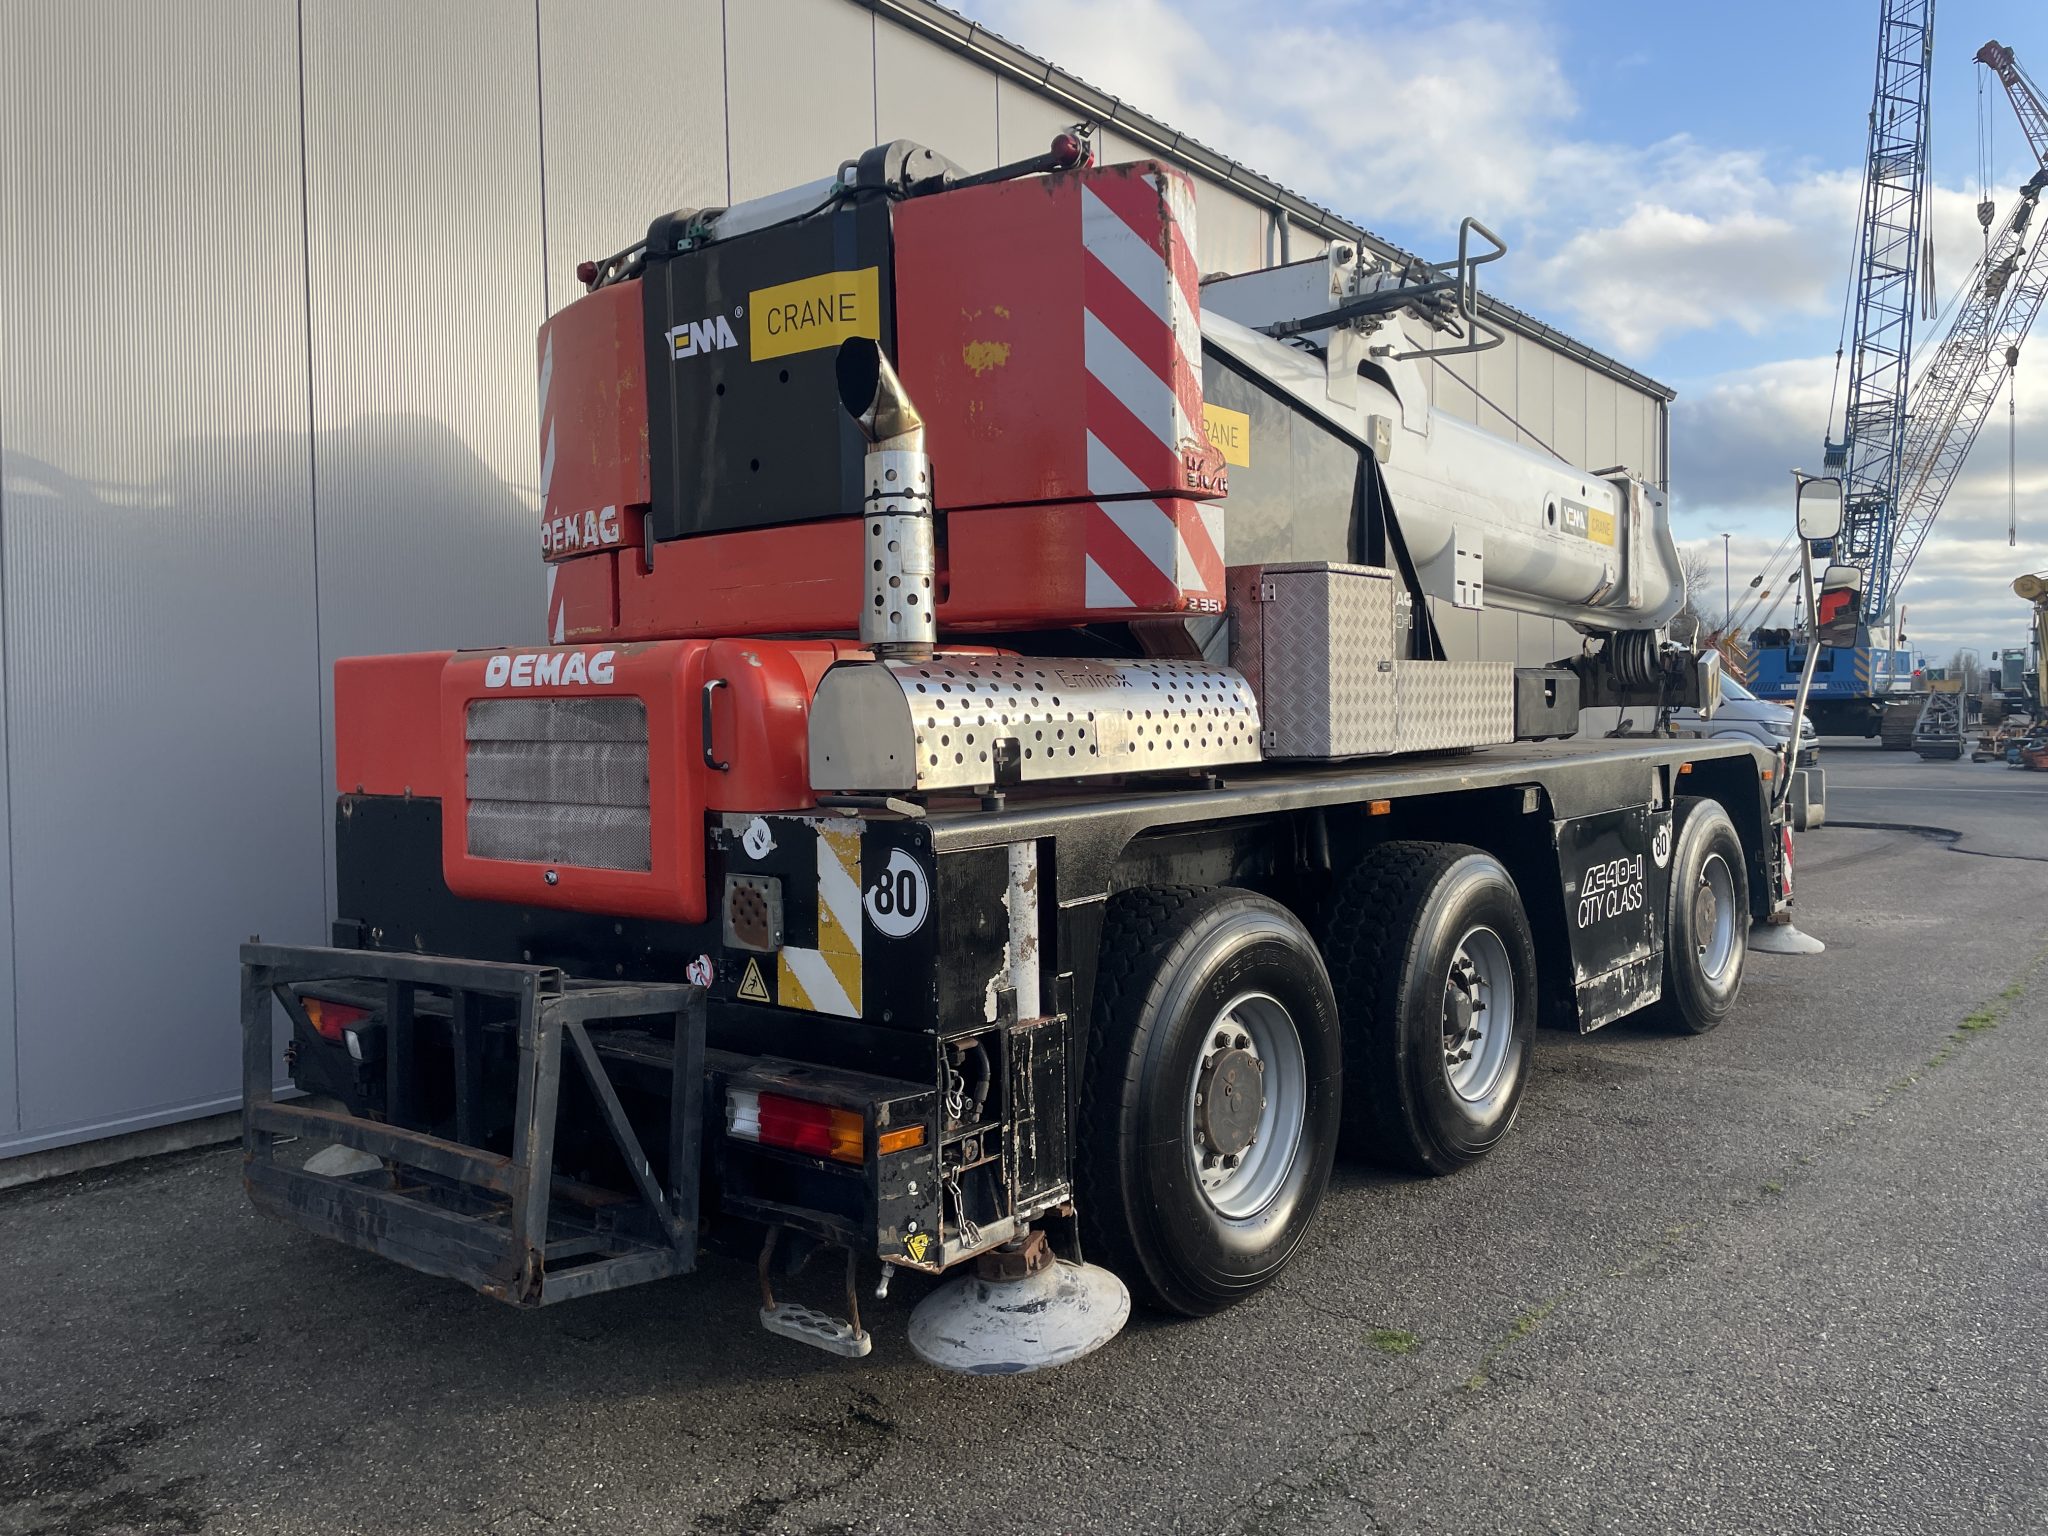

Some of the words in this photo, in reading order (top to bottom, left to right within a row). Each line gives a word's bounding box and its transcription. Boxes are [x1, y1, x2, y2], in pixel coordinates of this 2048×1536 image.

[767, 293, 857, 335] CRANE
[1202, 418, 1239, 449] RANE
[541, 505, 619, 551] DEMAG
[1563, 505, 1586, 531] VEMA
[1591, 517, 1611, 536] CRANE
[484, 650, 616, 688] DEMAG
[1054, 669, 1133, 688] Eminox
[1655, 832, 1667, 858] 80
[874, 868, 917, 918] 80
[1577, 893, 1605, 929] CITY
[1606, 881, 1643, 919] CLASS
